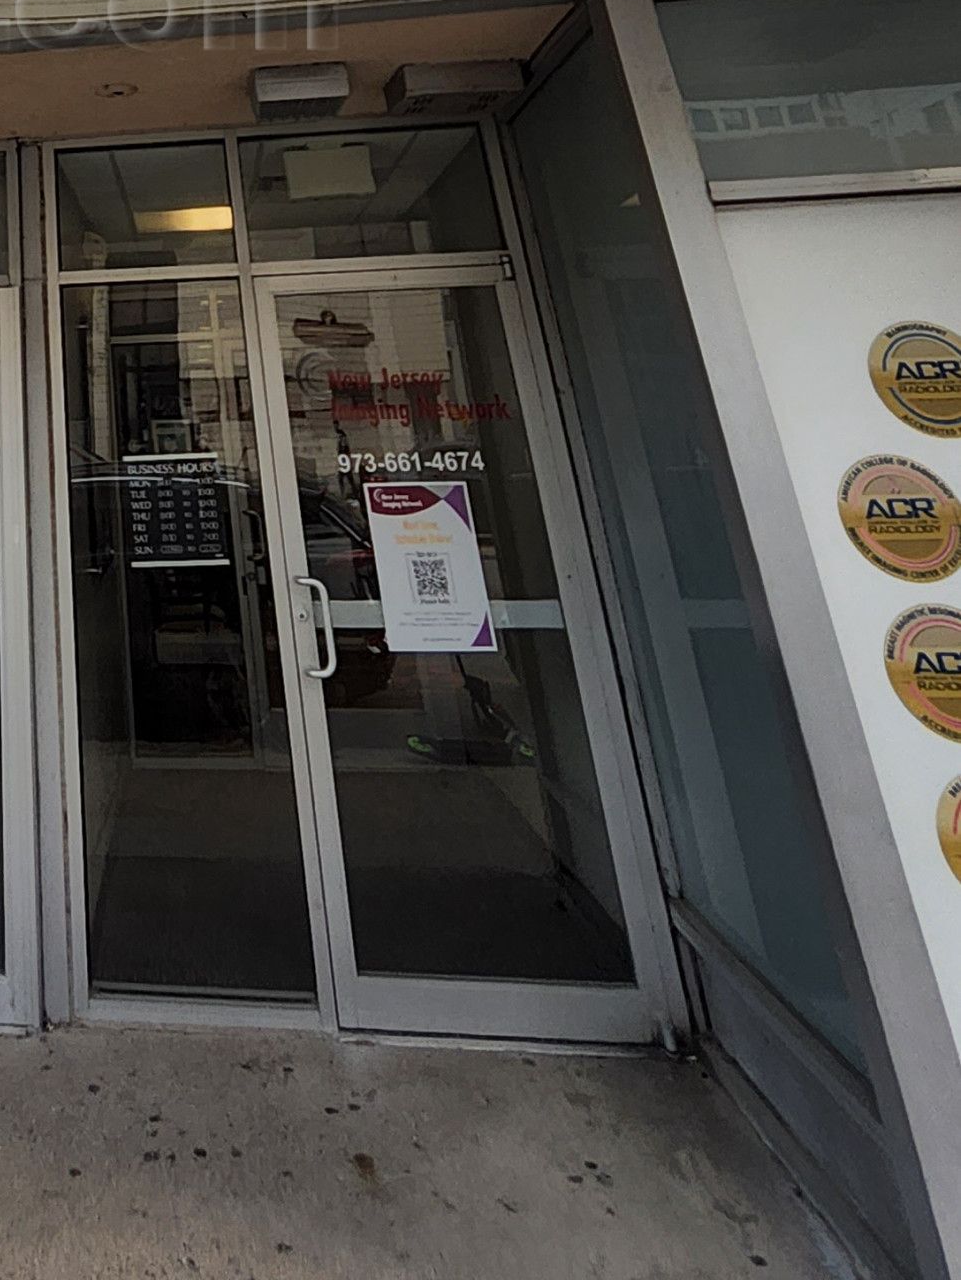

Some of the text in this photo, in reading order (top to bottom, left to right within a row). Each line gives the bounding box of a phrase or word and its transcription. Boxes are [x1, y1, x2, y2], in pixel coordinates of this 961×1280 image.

[895, 360, 961, 381] ACR
[328, 366, 444, 393] New Jersey
[415, 392, 512, 421] Network
[337, 450, 486, 473] 973-661-4674
[127, 462, 214, 474] BUSINESS HOURS
[130, 500, 152, 510] WED
[866, 498, 939, 519] ACR
[132, 512, 151, 521] THU
[132, 523, 147, 532] FRI
[133, 534, 149, 544] SAT
[134, 545, 154, 555] SUN
